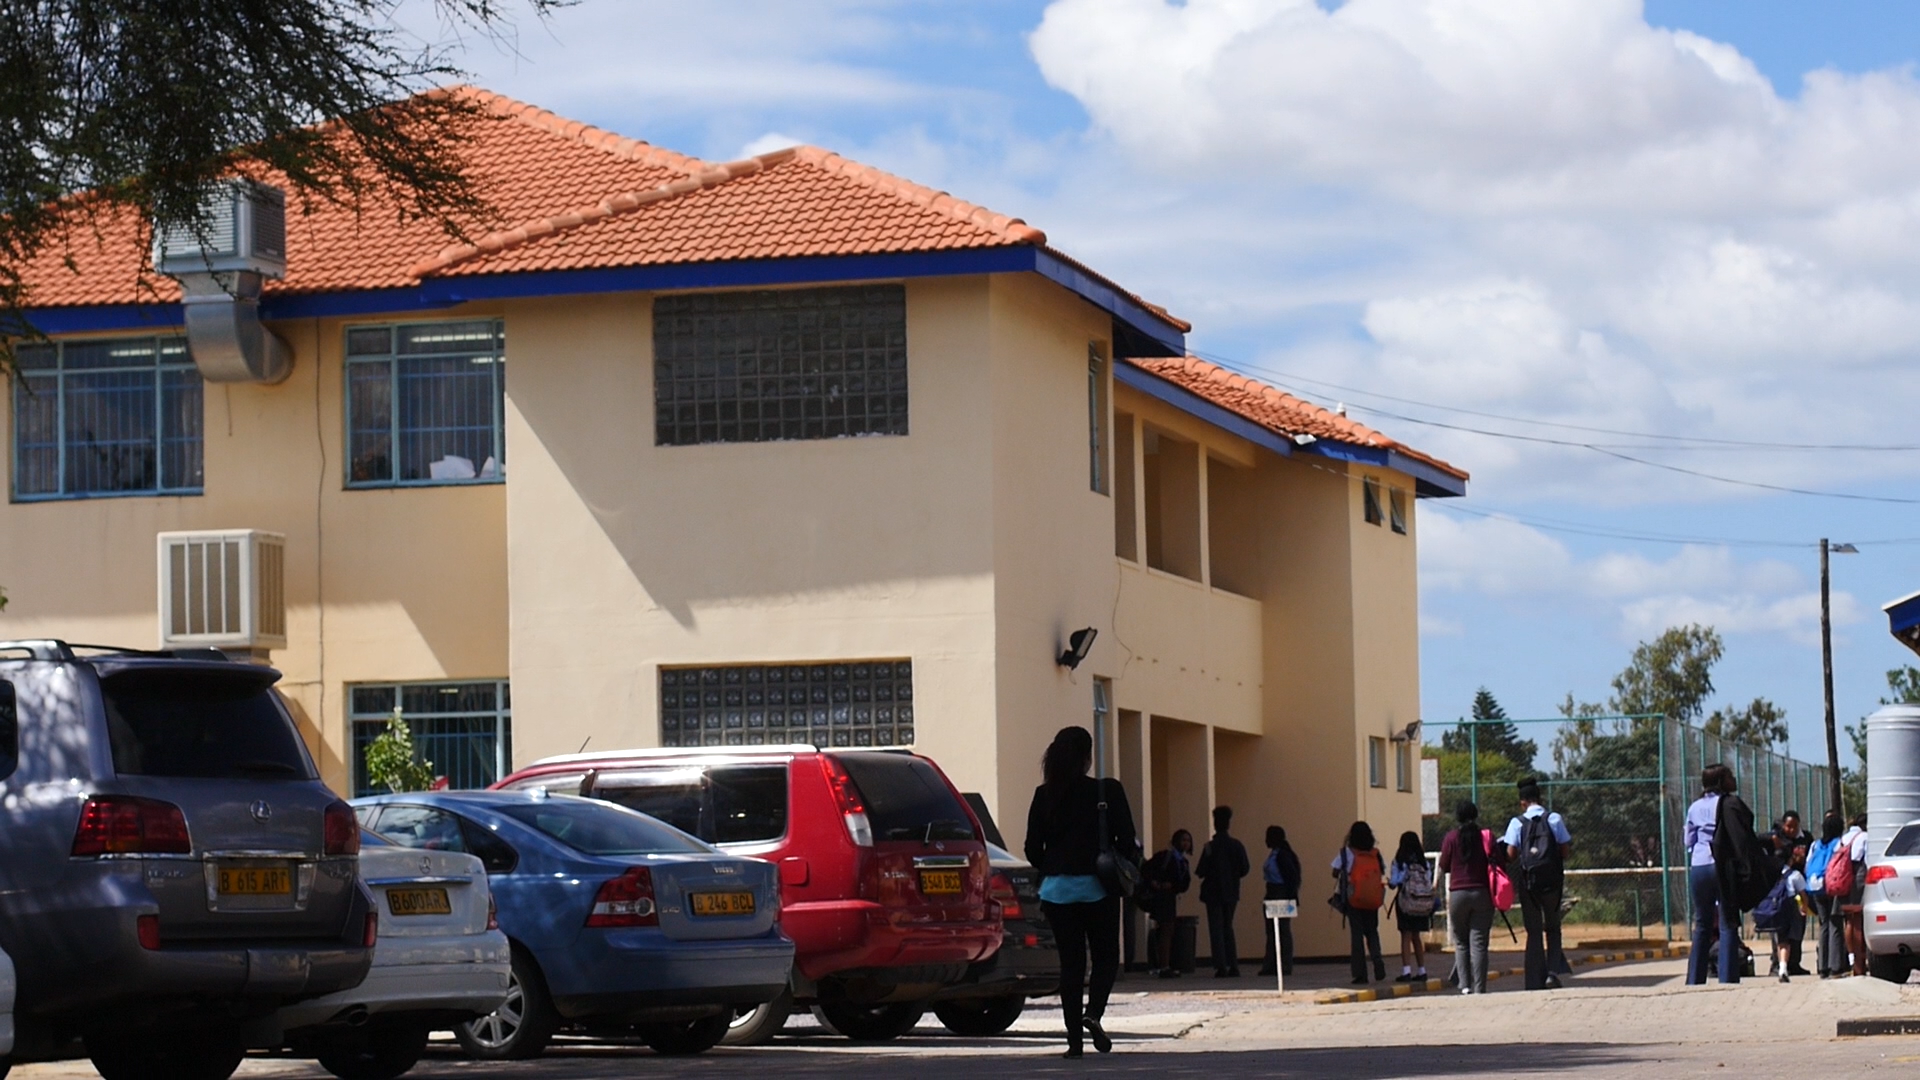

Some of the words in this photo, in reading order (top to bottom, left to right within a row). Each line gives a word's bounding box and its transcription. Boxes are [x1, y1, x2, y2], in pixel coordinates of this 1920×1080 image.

[221, 871, 230, 891] B
[237, 871, 257, 891] 615
[263, 871, 287, 891] ART
[695, 896, 704, 912] B
[708, 895, 728, 911] 246
[732, 894, 753, 911] BCL
